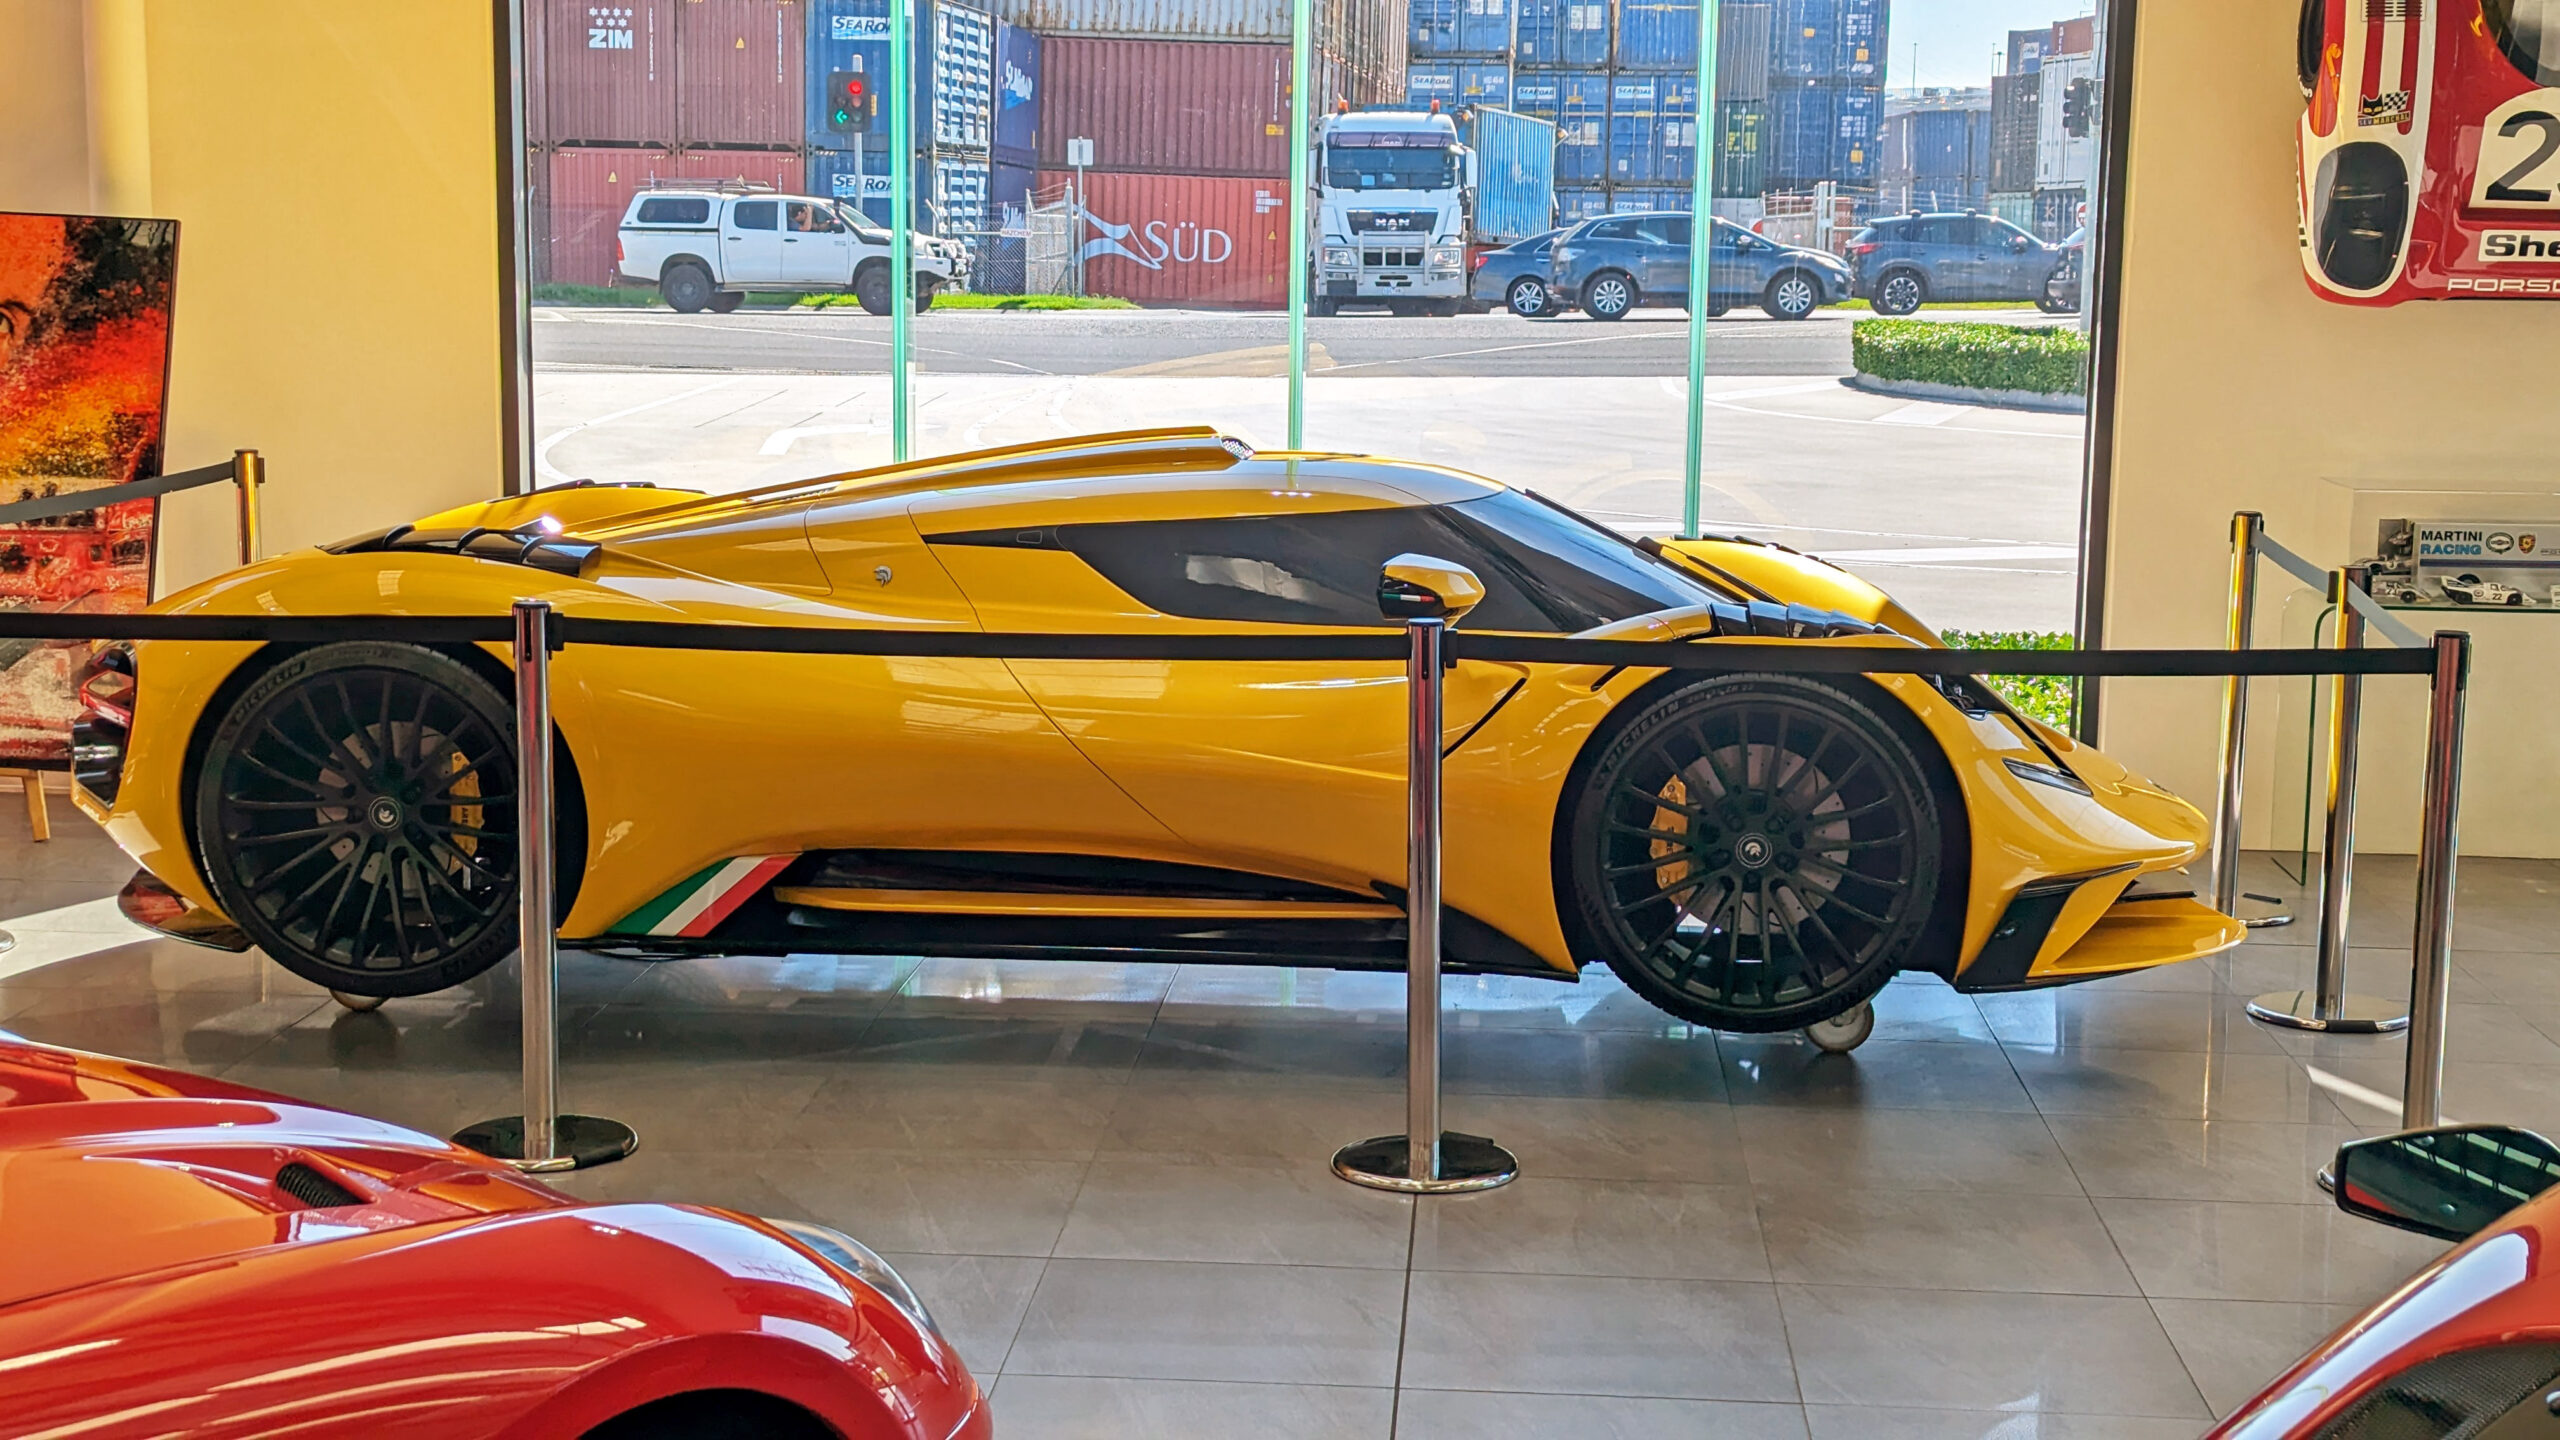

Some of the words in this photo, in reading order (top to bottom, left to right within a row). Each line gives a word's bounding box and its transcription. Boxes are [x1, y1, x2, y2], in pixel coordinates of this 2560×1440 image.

[588, 28, 633, 50] ZIM
[2485, 110, 2560, 203] 2
[1375, 218, 1410, 226] MAN
[1145, 220, 1233, 263] SÜD
[2421, 530, 2482, 542] MARTINI
[2420, 543, 2482, 555] RACING
[1605, 701, 1680, 772] MICHELIN
